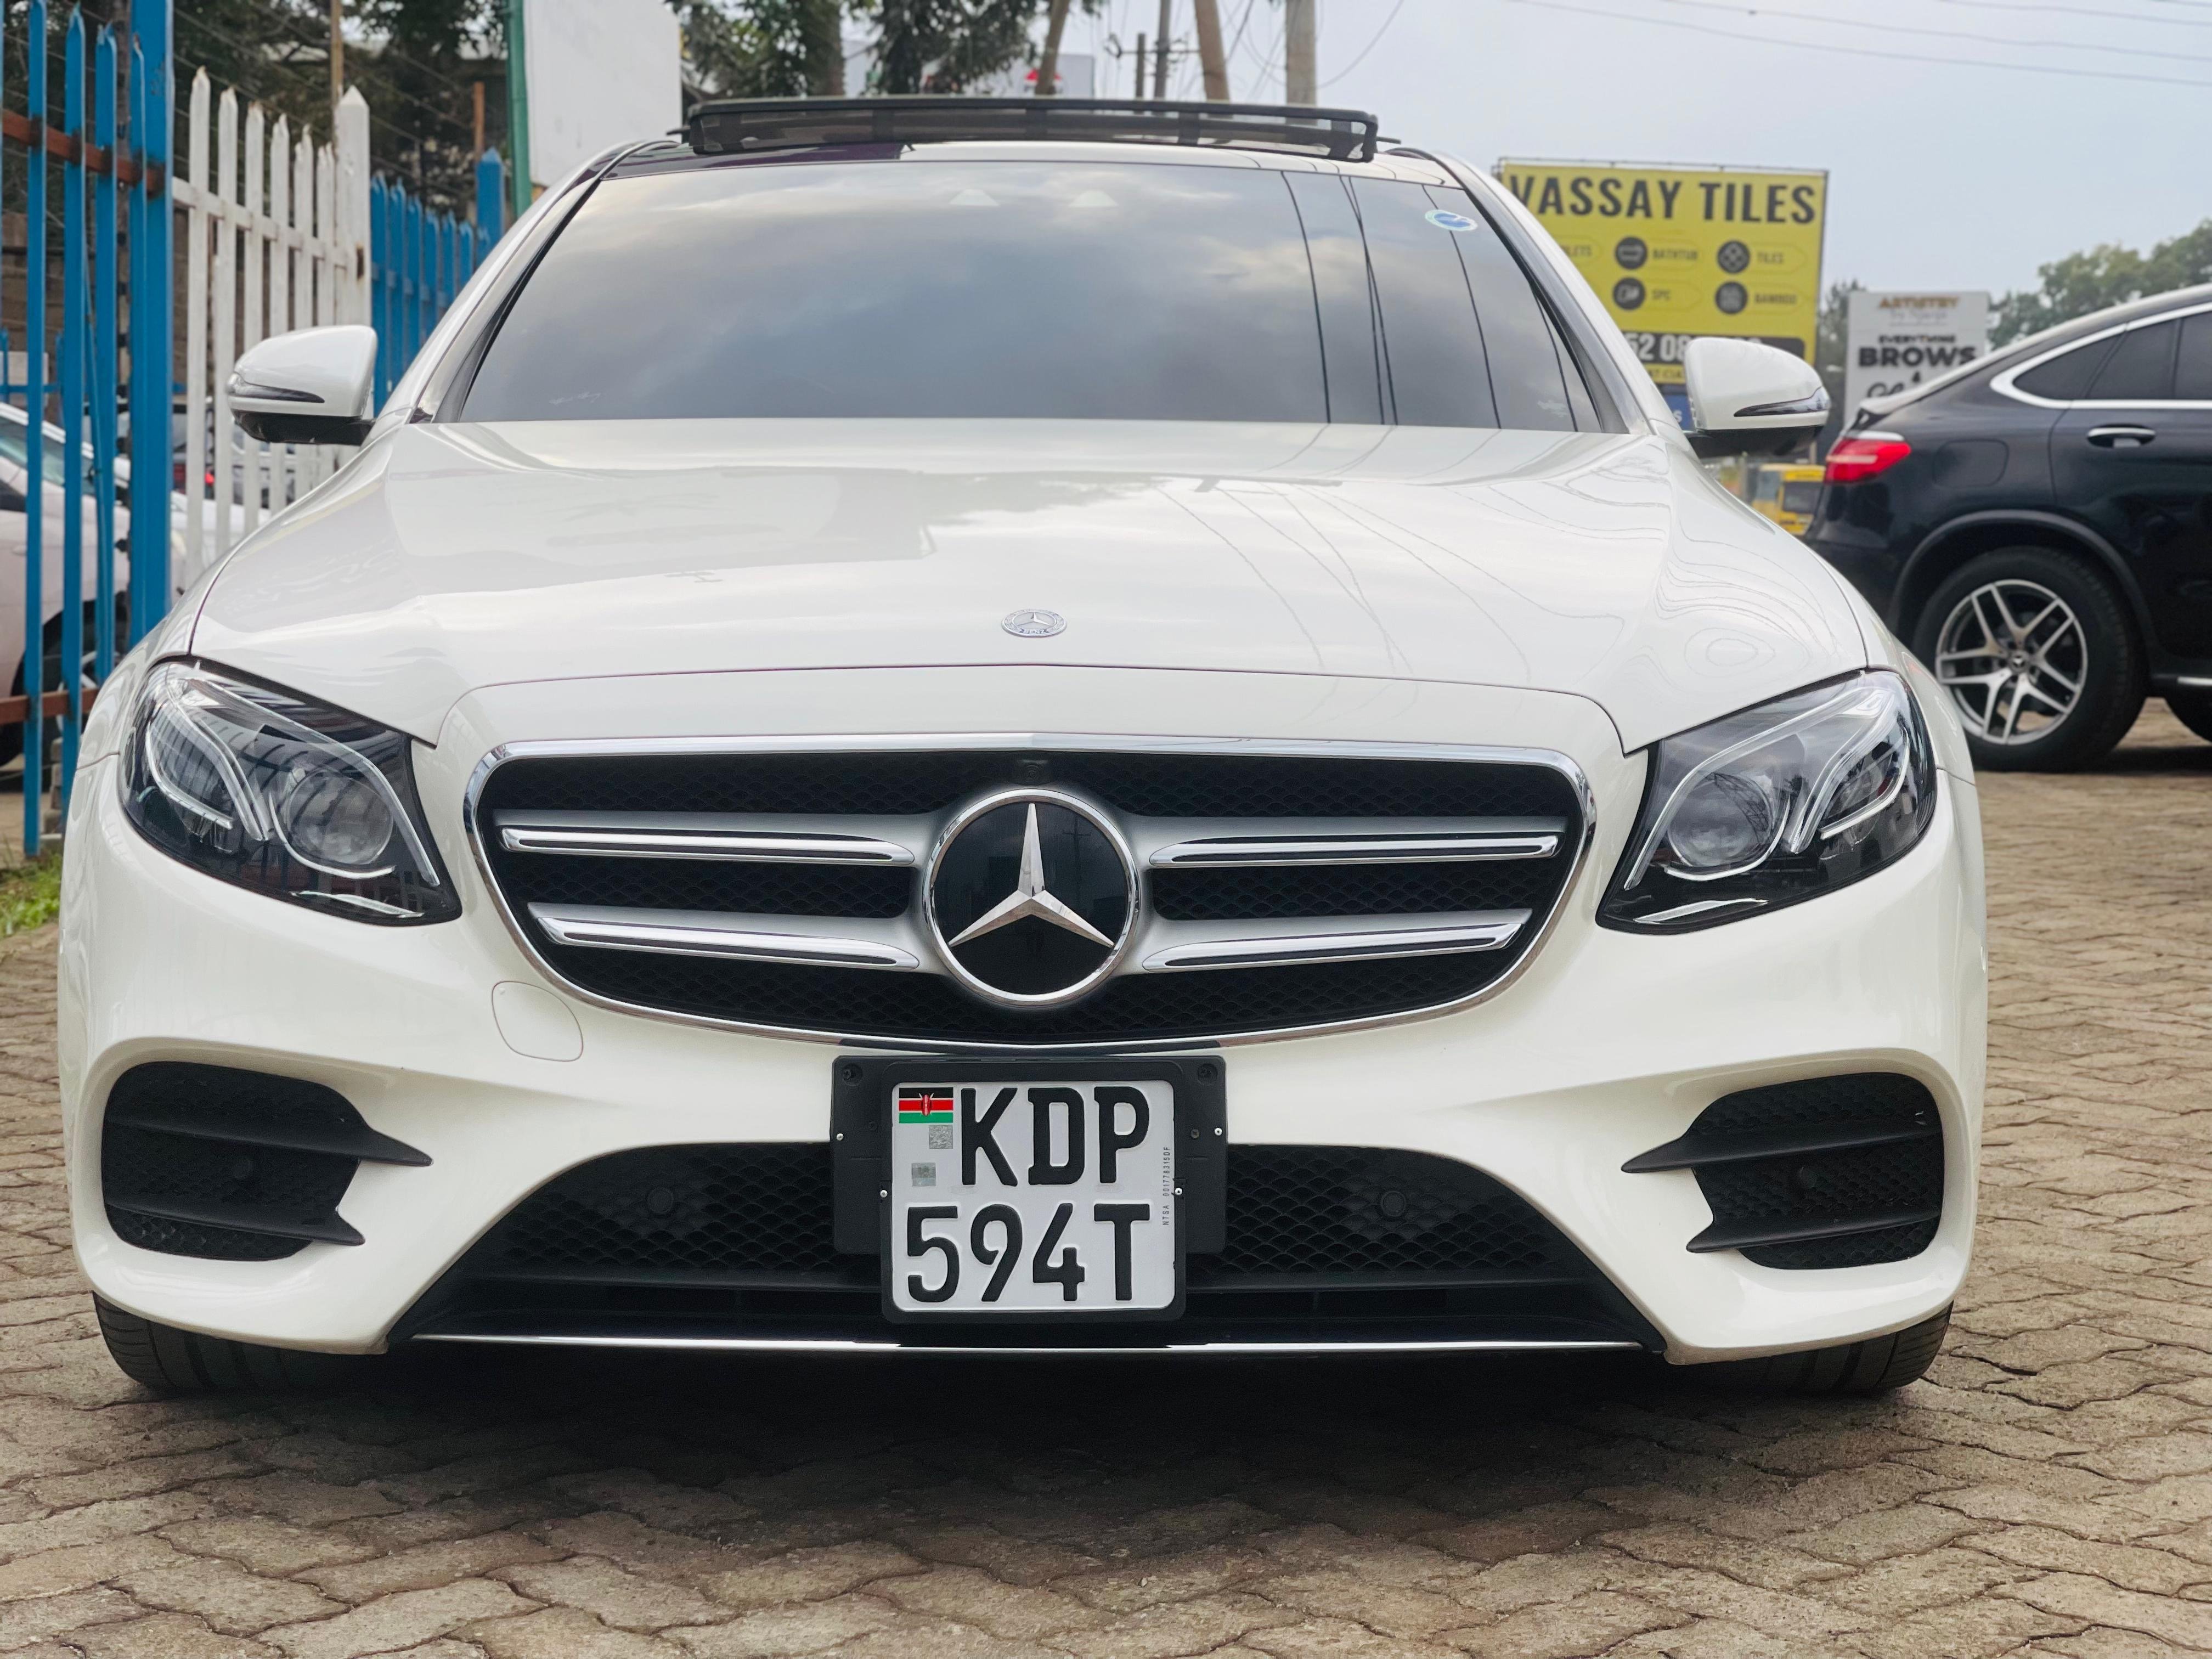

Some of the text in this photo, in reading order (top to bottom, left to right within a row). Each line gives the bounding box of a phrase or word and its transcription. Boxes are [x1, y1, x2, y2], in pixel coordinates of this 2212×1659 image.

[1511, 176, 1816, 223] VASSAY TILES
[1859, 346, 1976, 368] BROWS
[961, 1086, 1150, 1187] KDP
[907, 1203, 1150, 1302] 594T
